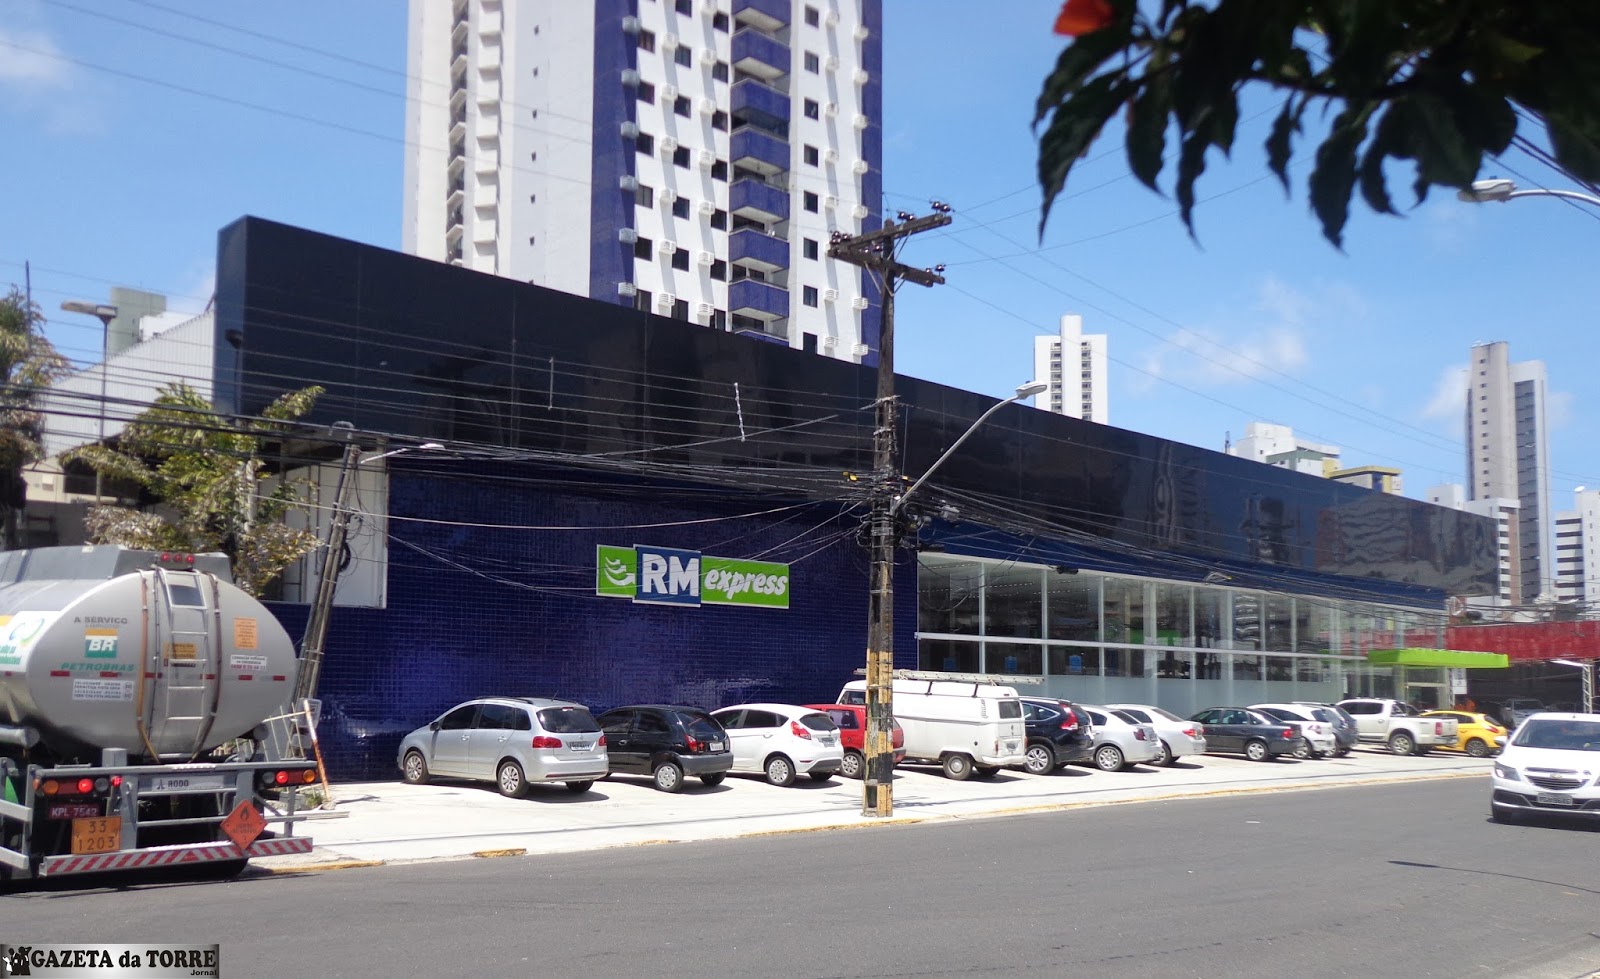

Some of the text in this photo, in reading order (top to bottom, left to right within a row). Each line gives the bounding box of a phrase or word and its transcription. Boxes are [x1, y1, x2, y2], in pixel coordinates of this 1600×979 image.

[642, 553, 788, 600] RM express
[88, 639, 115, 651] BR
[61, 662, 135, 671] PETROBRAS
[89, 820, 107, 833] 33
[78, 836, 115, 851] 1203
